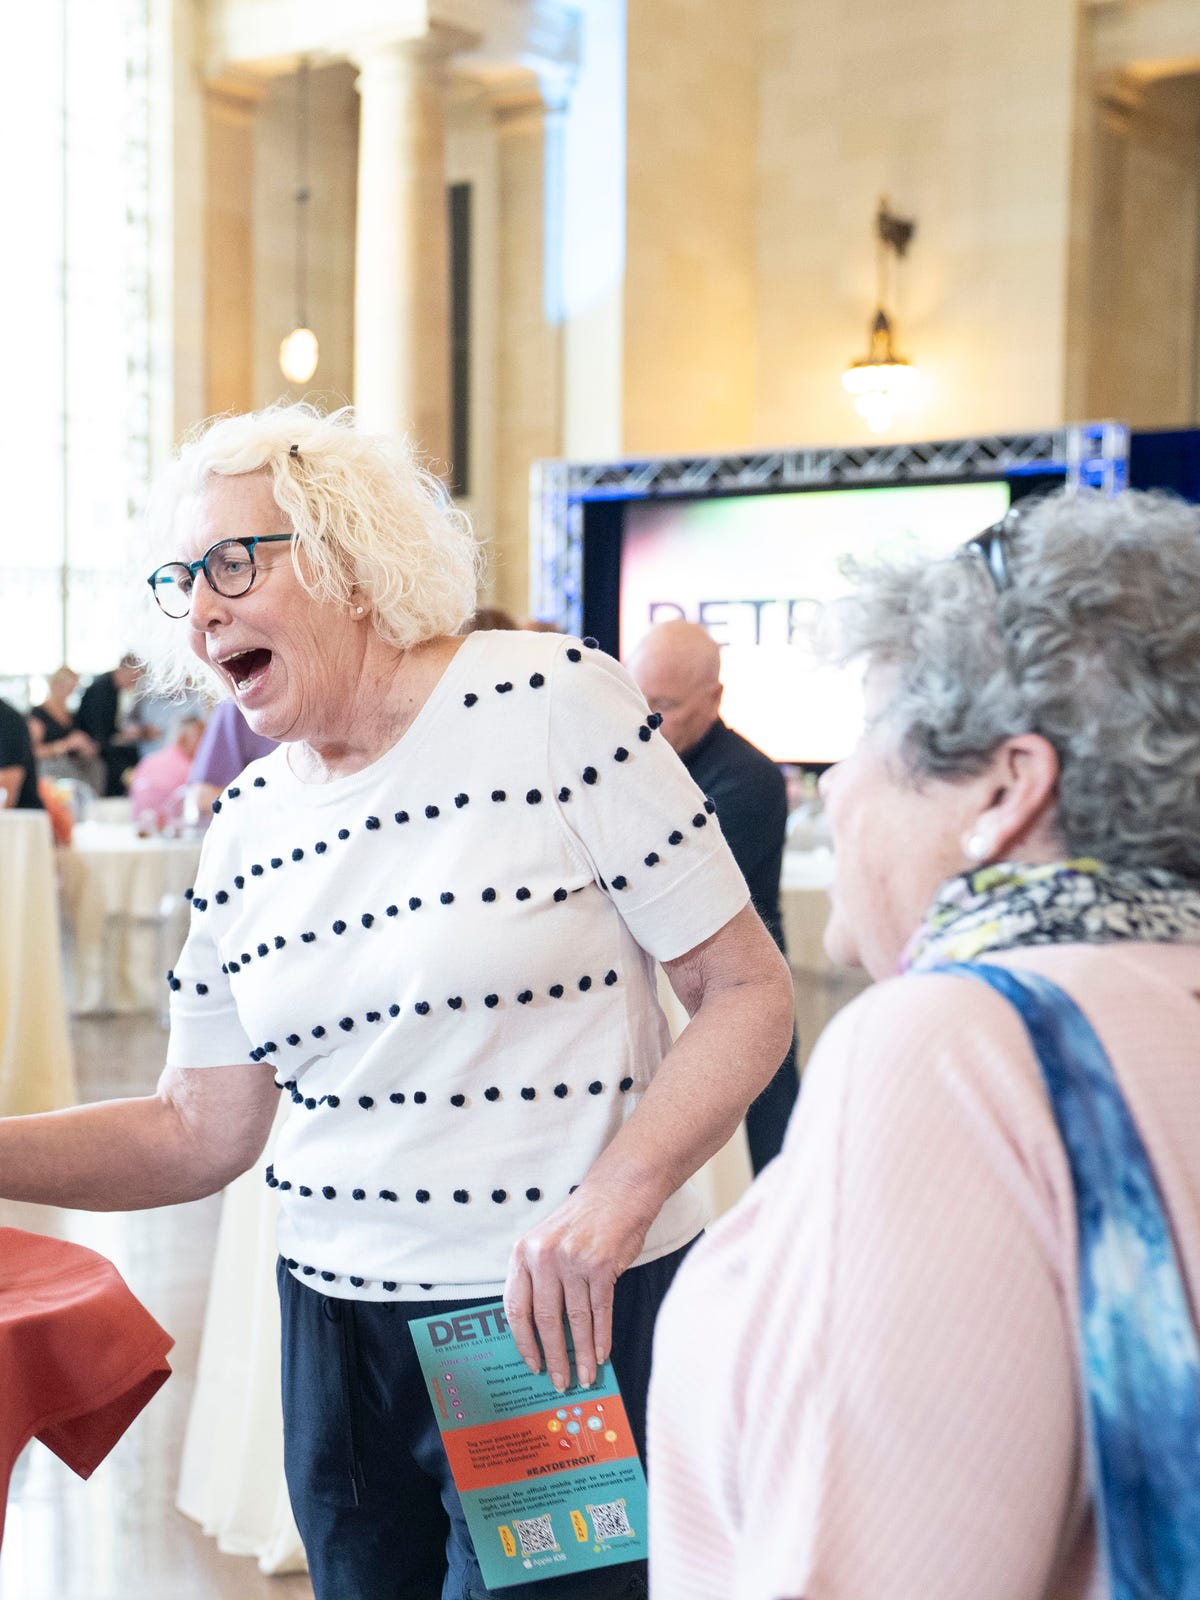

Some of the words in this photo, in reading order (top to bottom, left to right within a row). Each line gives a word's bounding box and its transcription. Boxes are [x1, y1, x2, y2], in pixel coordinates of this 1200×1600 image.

[426, 1306, 511, 1347] DETR
[525, 1454, 597, 1476] #EATDETROIT
[478, 1492, 510, 1504] Download
